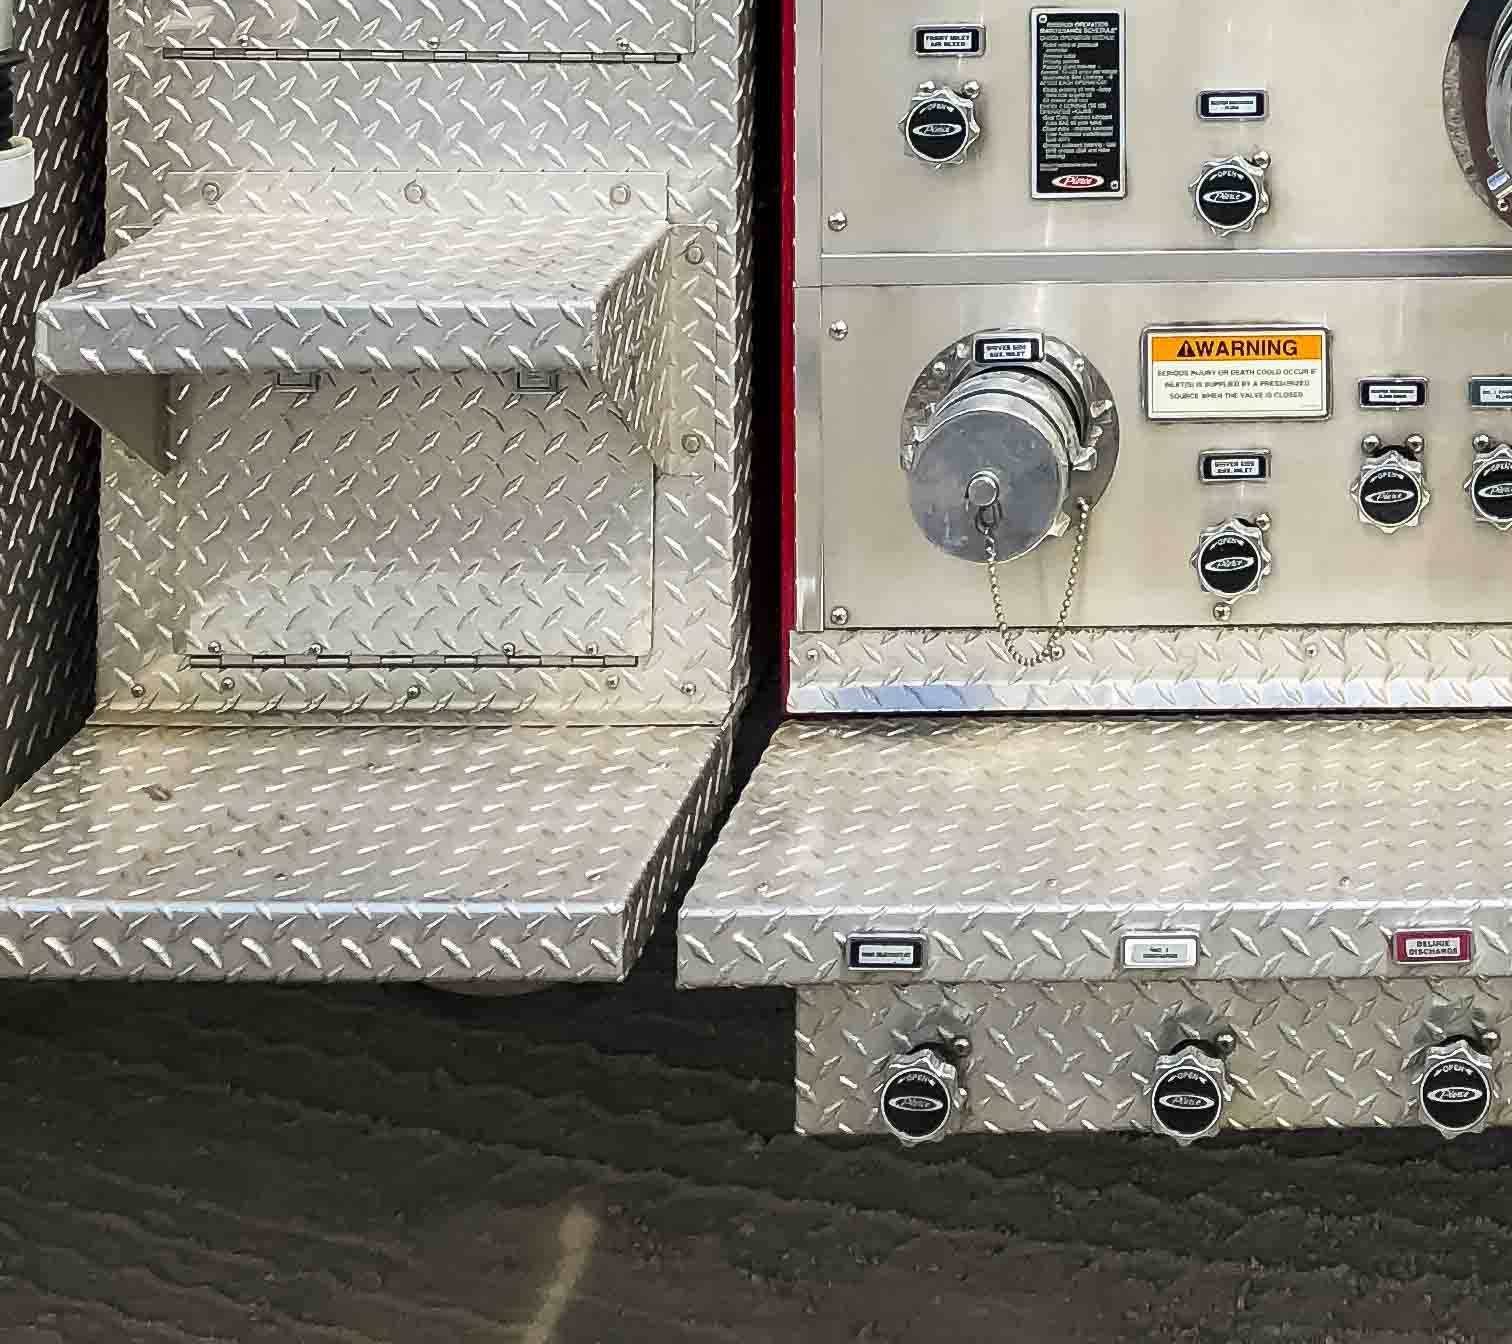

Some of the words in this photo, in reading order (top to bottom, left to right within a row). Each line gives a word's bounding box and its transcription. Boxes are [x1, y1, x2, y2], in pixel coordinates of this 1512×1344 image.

[1217, 170, 1238, 179] OPEN
[1195, 339, 1298, 357] WARNING
[1491, 462, 1512, 471] OPEN
[1377, 471, 1397, 480] OPEN
[1442, 1064, 1465, 1072] OPEN
[906, 1073, 928, 1081] OPEN
[1177, 1071, 1199, 1080] OPEN
